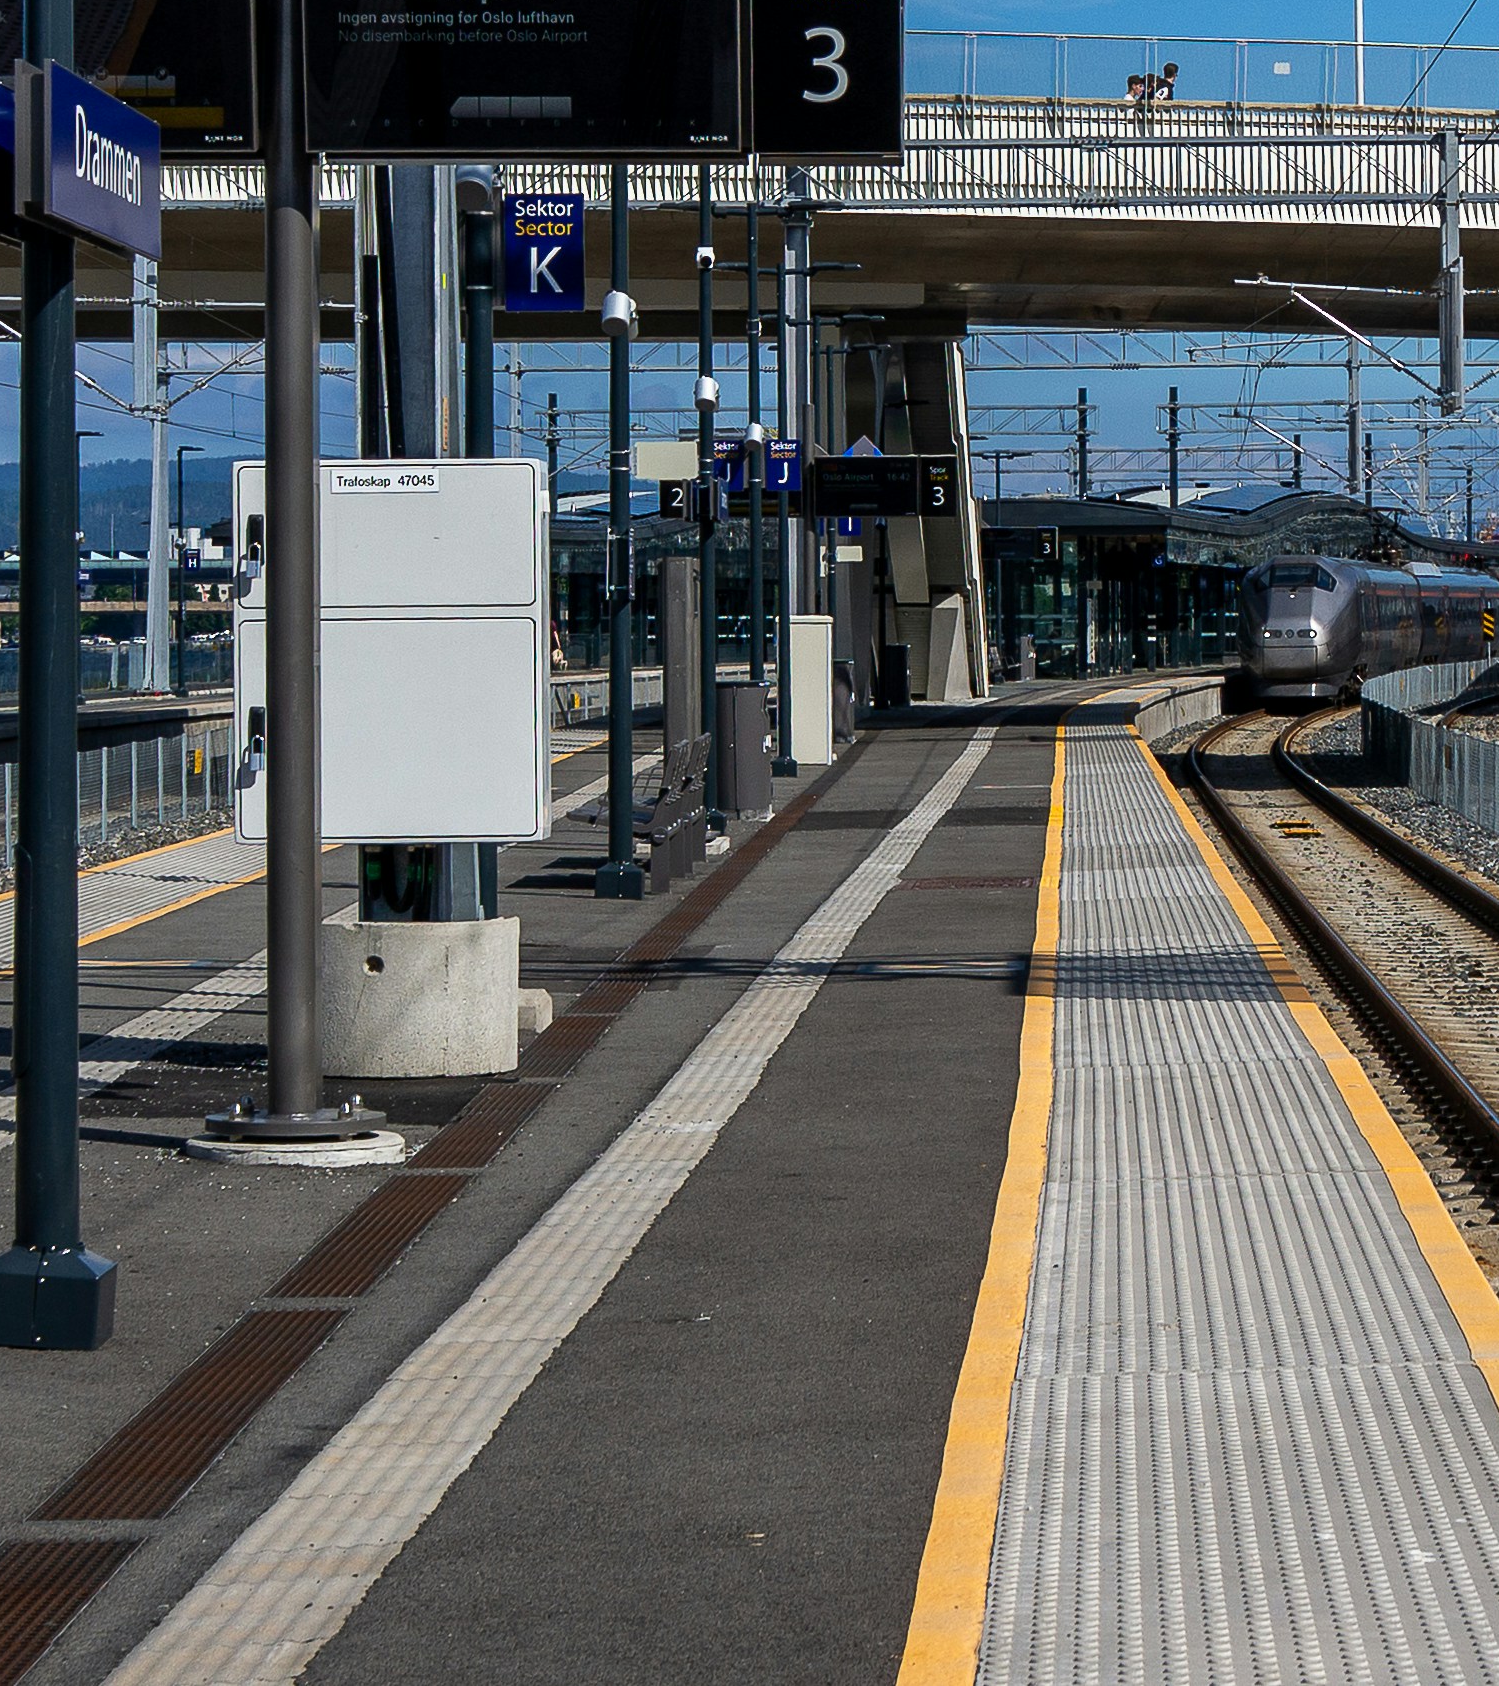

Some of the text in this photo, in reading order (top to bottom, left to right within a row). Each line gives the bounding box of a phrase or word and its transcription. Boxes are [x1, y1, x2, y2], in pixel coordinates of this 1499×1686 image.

[338, 12, 377, 27] Ingen
[381, 11, 454, 27] avstigning
[482, 11, 513, 24] Oslo
[517, 10, 575, 24] lufthavn
[338, 28, 589, 45] No disembarking before Oslo Airport
[802, 26, 849, 103] 3
[75, 104, 142, 207] Drammen
[515, 199, 575, 217] Sektor
[515, 219, 574, 236] Sector
[530, 246, 564, 293] K
[397, 475, 435, 487] 47045
[777, 461, 789, 484] J
[670, 487, 684, 507] 2
[932, 486, 946, 506] 3
[1042, 542, 1051, 554] 3
[188, 558, 197, 568] H
